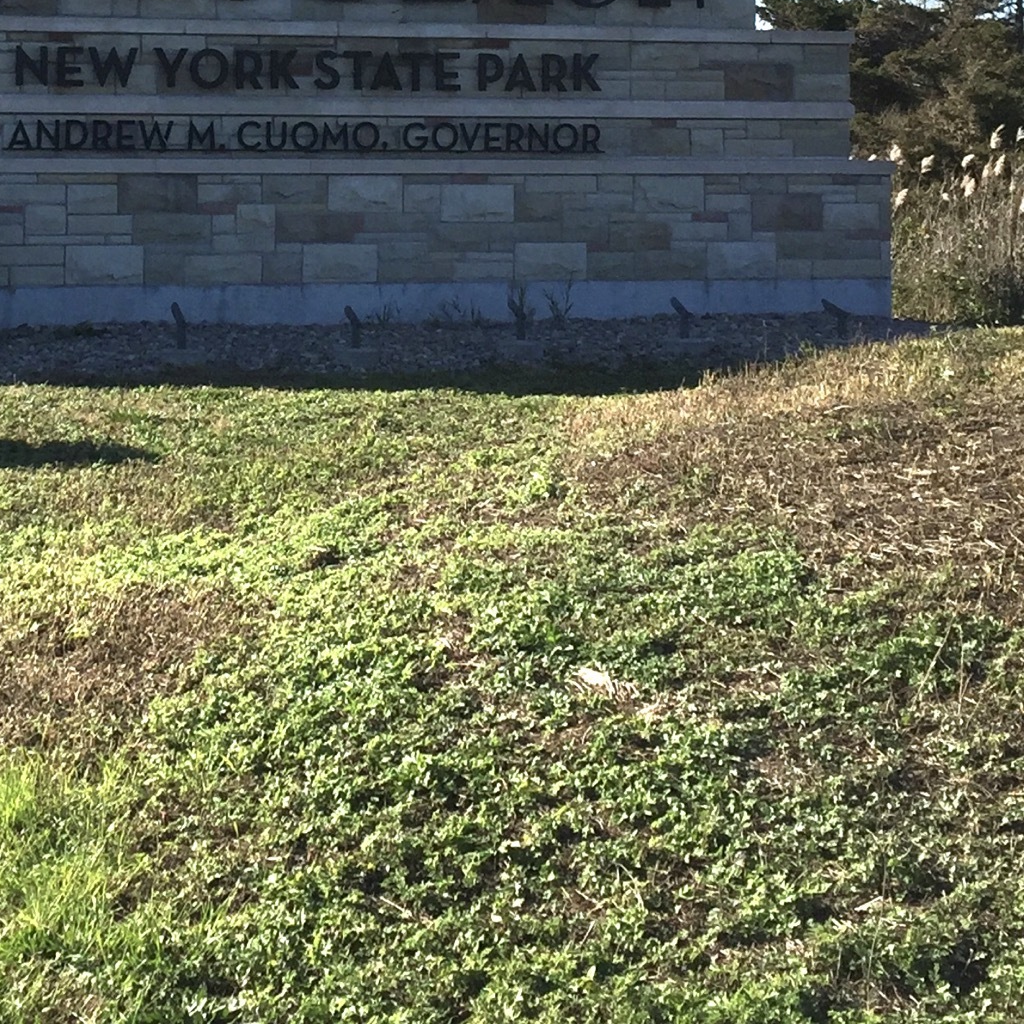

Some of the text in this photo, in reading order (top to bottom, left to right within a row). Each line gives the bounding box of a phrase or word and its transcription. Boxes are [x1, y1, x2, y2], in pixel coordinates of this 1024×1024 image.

[15, 45, 602, 92] NEW YORK STATE PARK
[7, 119, 603, 153] ANDREW M. CUOMO, GOVERNOR
